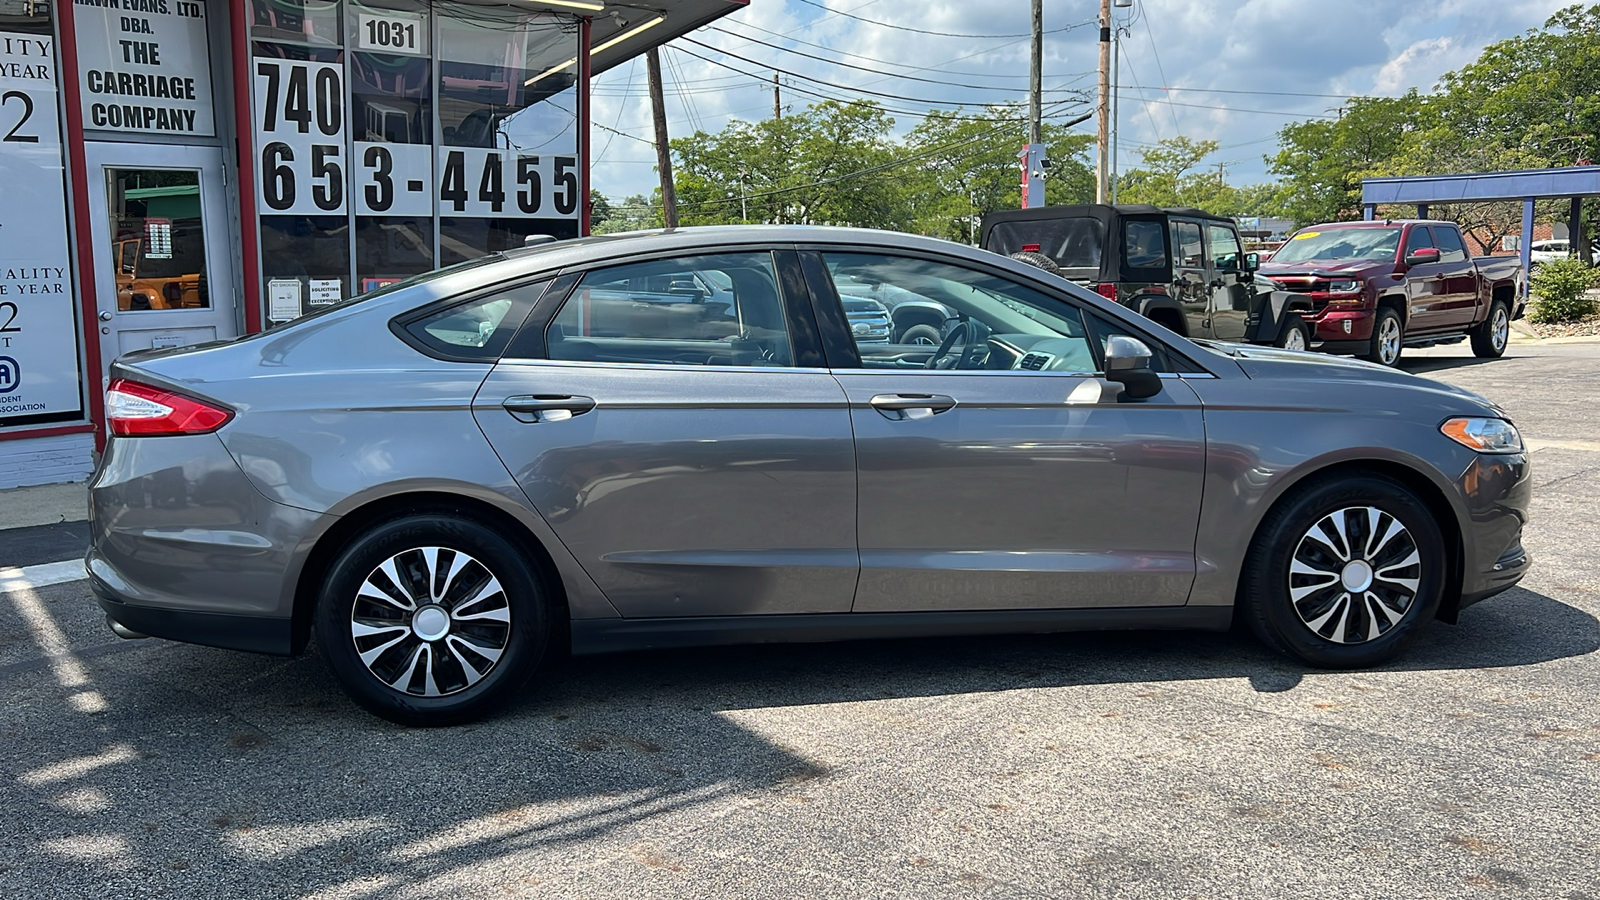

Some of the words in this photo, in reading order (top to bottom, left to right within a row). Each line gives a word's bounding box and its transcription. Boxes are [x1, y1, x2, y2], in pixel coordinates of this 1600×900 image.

[177, 1, 203, 18] LTD.
[121, 17, 154, 34] DBA.
[366, 20, 415, 48] 1031
[119, 40, 160, 65] THE
[0, 62, 50, 80] YEAR
[87, 70, 196, 100] CARRIAGE
[258, 63, 342, 136] 740
[92, 103, 196, 131] COMPANY
[0, 267, 64, 280] ALITY
[17, 283, 63, 294] YEAR
[0, 395, 21, 403] DENT
